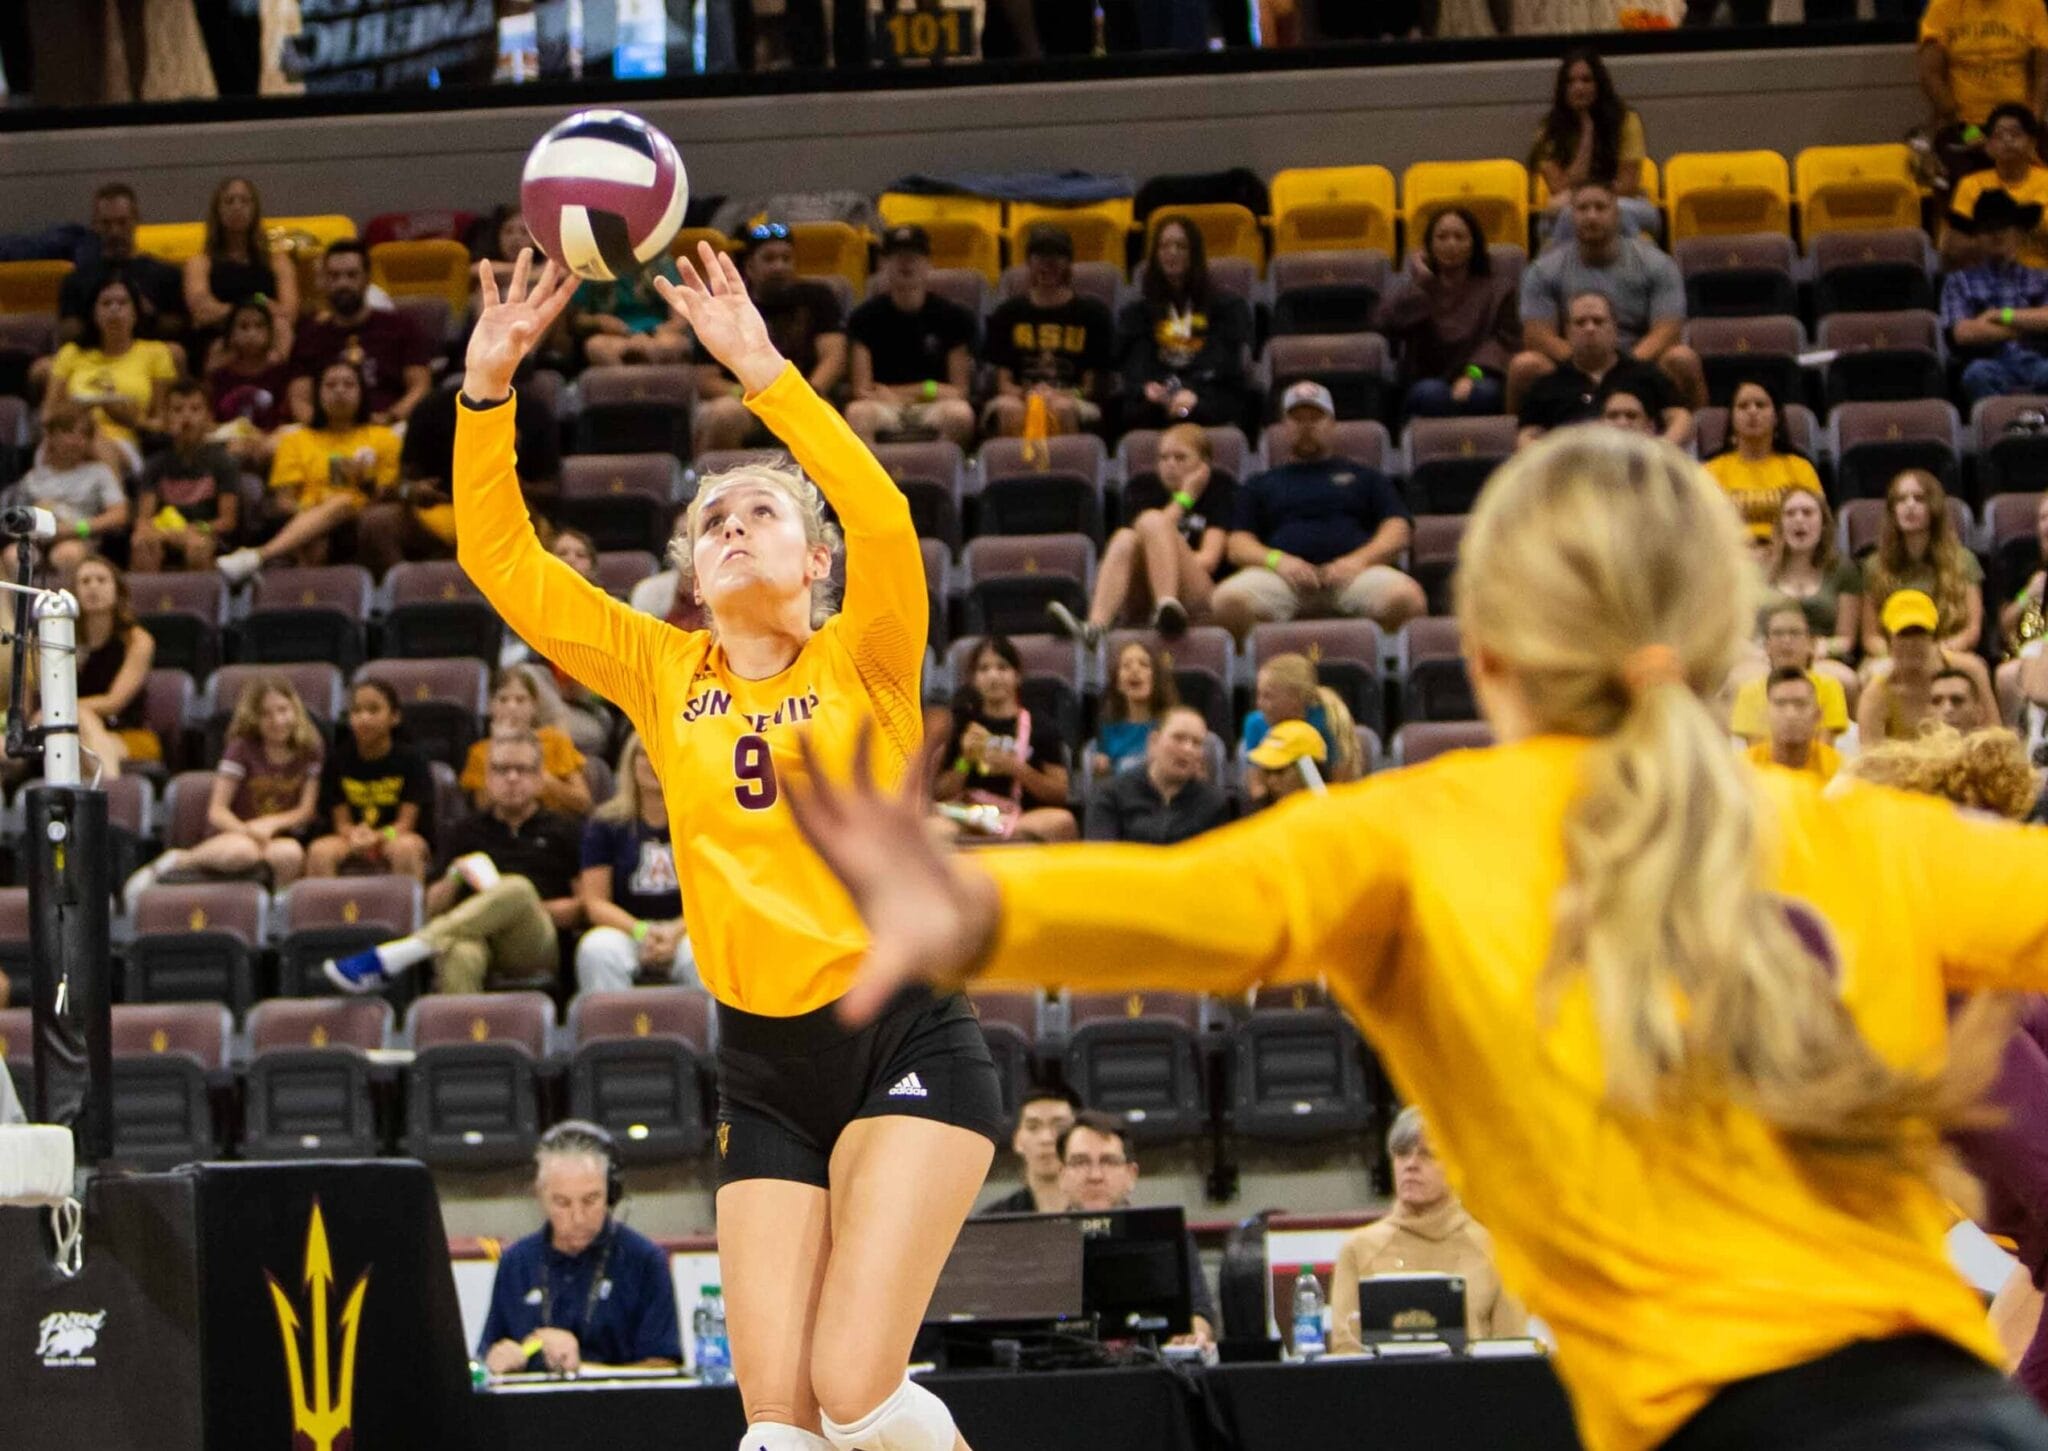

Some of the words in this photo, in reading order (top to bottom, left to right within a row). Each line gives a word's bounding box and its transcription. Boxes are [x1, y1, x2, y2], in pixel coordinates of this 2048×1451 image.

[887, 13, 959, 55] 101
[1013, 322, 1085, 352] ASU
[683, 689, 732, 722] SUN
[734, 735, 778, 810] 9
[889, 1087, 927, 1097] adidas
